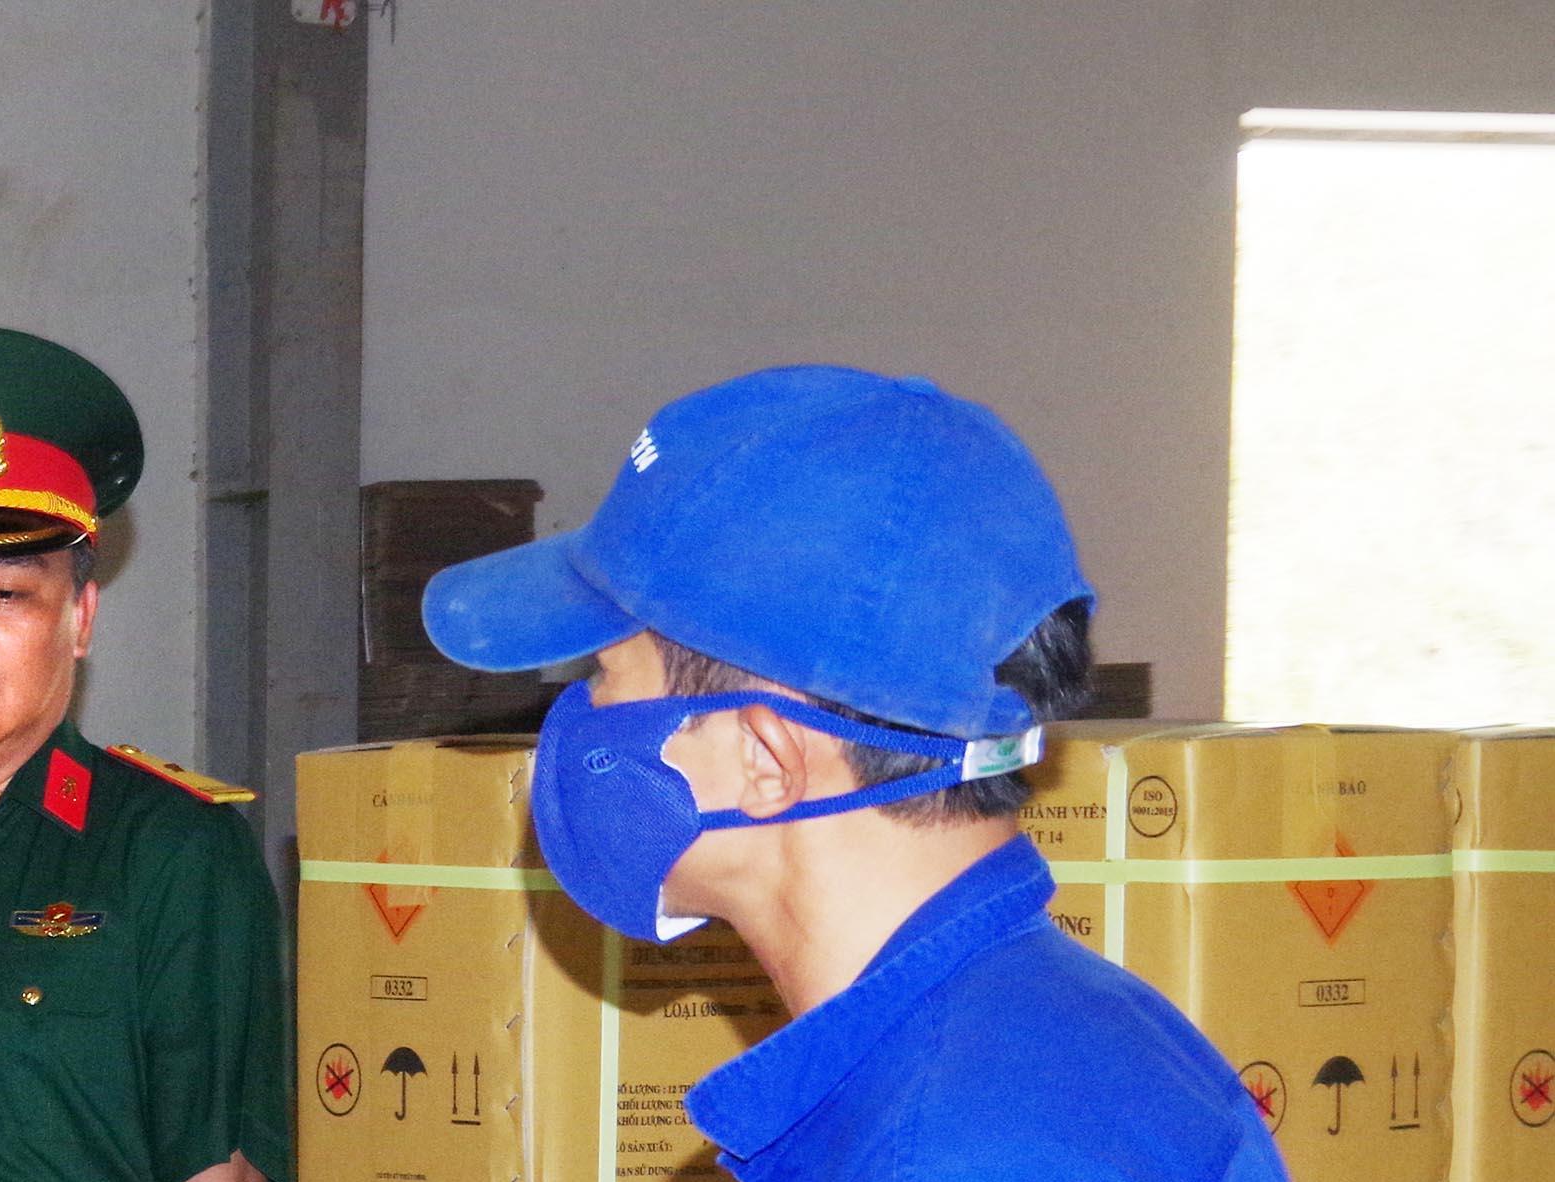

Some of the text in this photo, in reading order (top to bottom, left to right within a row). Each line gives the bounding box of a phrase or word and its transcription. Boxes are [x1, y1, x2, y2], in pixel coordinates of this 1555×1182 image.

[1142, 790, 1163, 801] ISO
[1132, 806, 1174, 817] 9001:2015
[1049, 831, 1064, 844] 14
[385, 979, 413, 996] 0332
[1315, 984, 1350, 1002] 0332
[663, 1001, 697, 1021] LOẠI
[629, 1083, 661, 1097] LƯỢNG
[668, 1085, 677, 1094] 12
[641, 1099, 673, 1111] LƯỢNG
[641, 1115, 672, 1128] LƯỢNG
